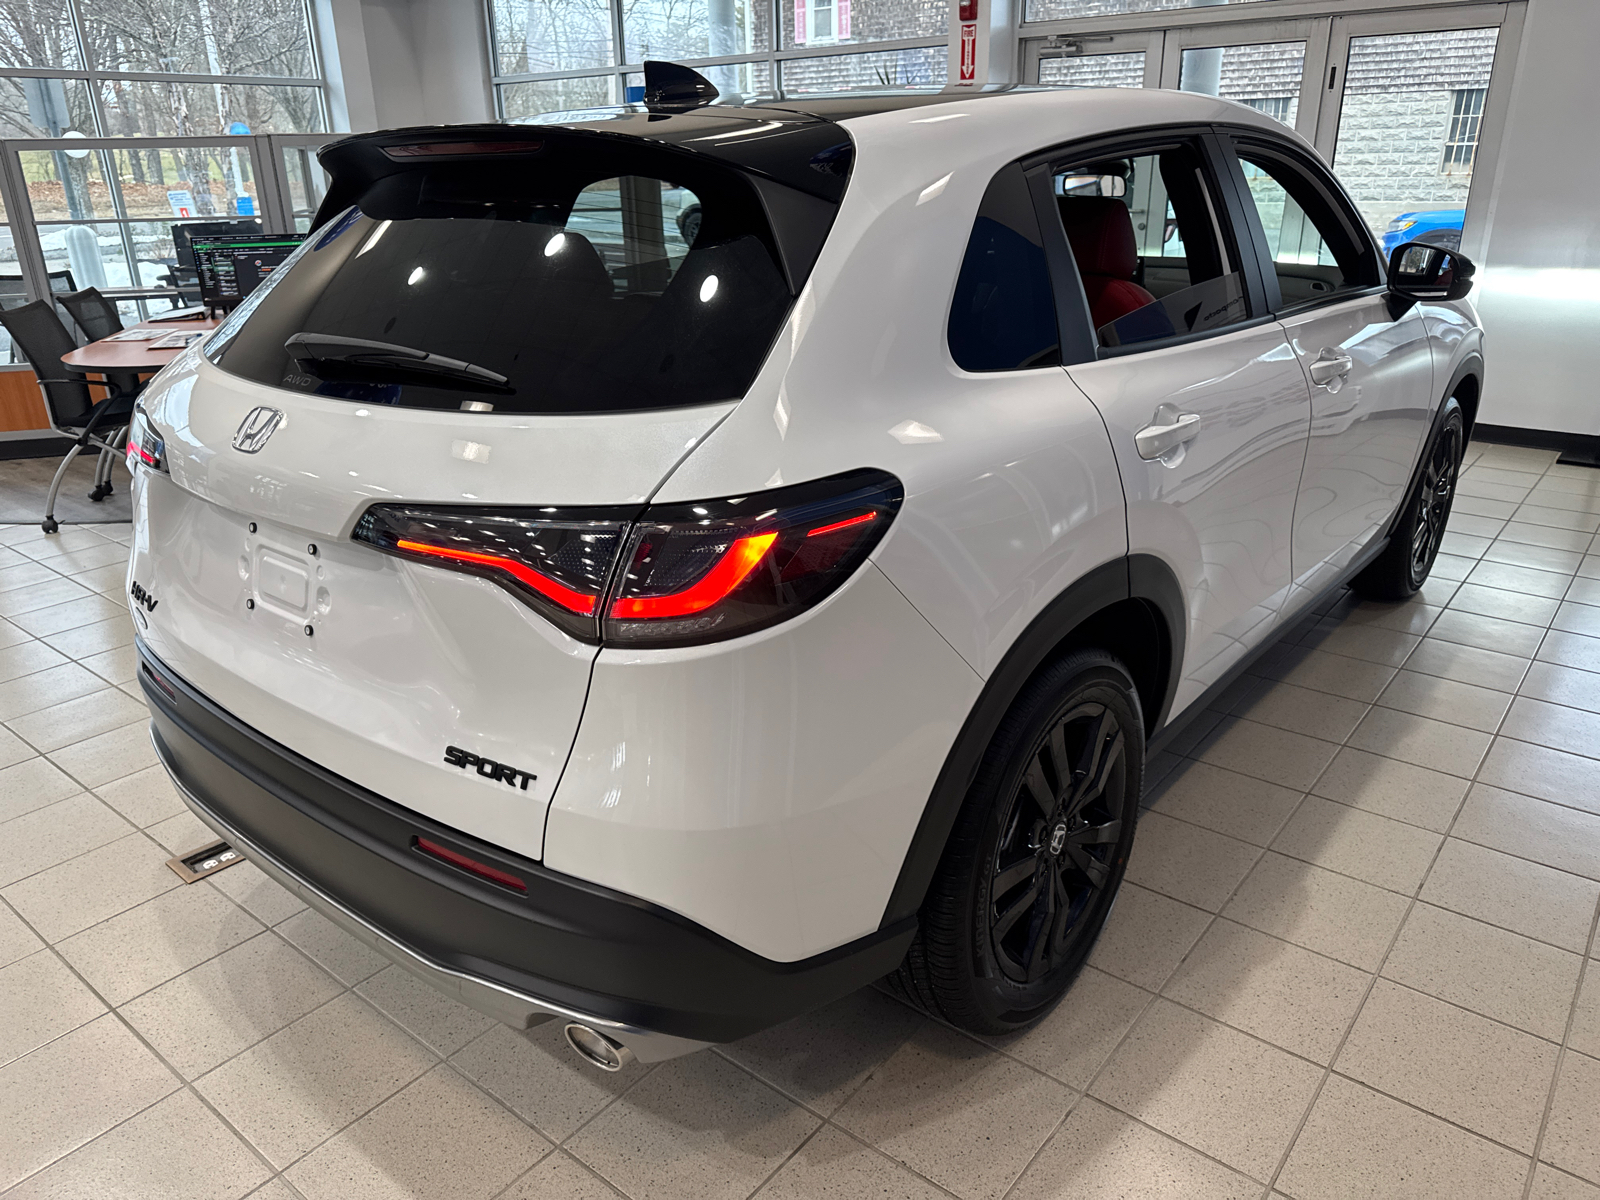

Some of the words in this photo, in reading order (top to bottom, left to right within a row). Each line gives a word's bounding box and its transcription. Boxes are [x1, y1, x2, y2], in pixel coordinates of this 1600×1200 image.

[283, 374, 312, 387] AWD
[131, 580, 159, 612] HR-V
[444, 745, 538, 791] SPORT
[976, 877, 987, 958] KINERGY
